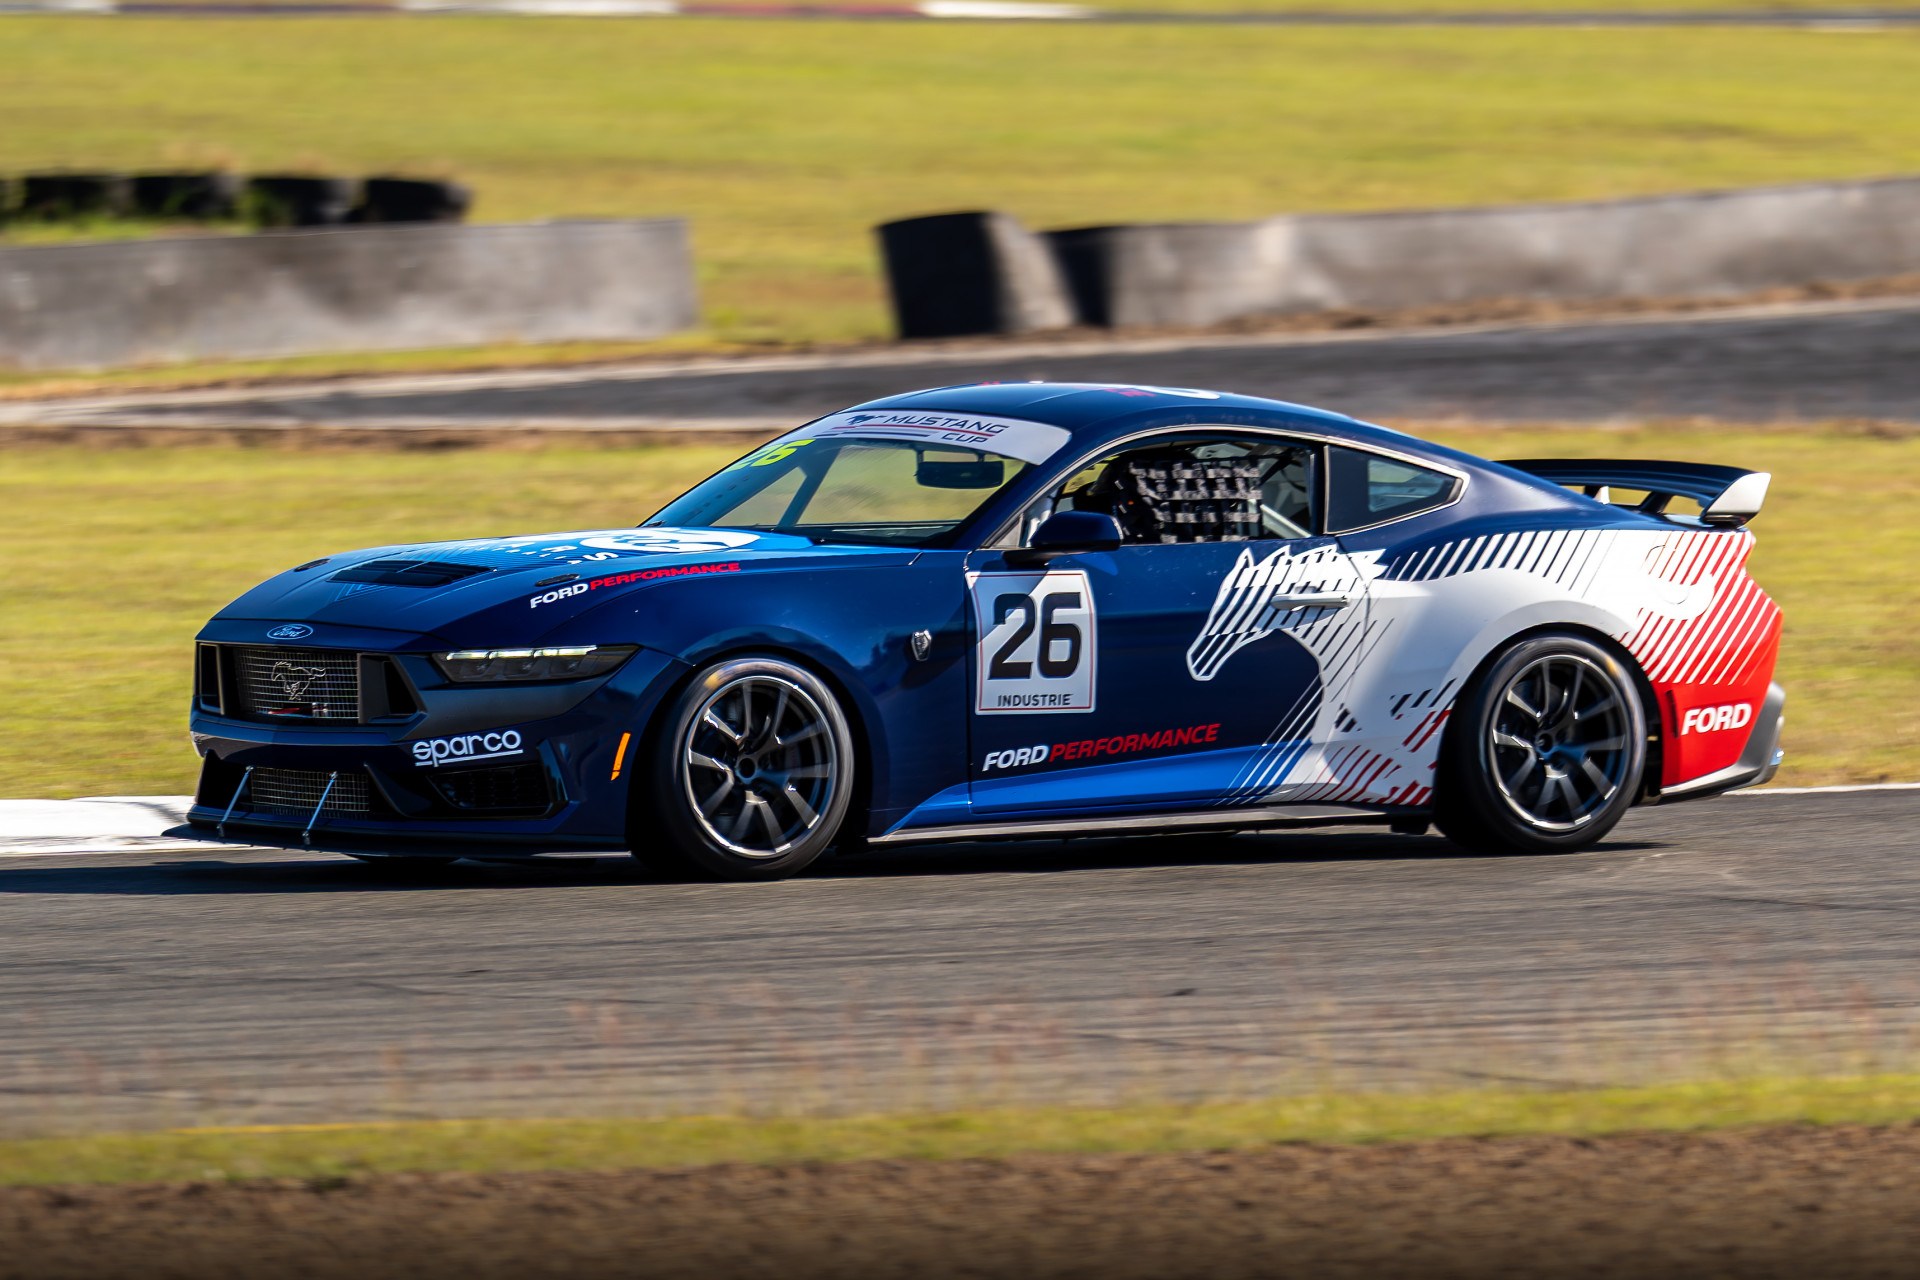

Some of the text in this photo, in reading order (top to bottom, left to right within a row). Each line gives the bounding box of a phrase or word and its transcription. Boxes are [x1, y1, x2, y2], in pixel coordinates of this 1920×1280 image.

[883, 415, 1009, 434] MUSTANG
[941, 432, 988, 443] CUP
[530, 562, 741, 608] FORD PERFORMANCE
[987, 591, 1082, 680] 26
[997, 693, 1073, 707] INDUSTRIE
[1681, 703, 1752, 735] FORD
[412, 730, 522, 767] sparco
[982, 723, 1221, 772] FORD PERFORMANCE
